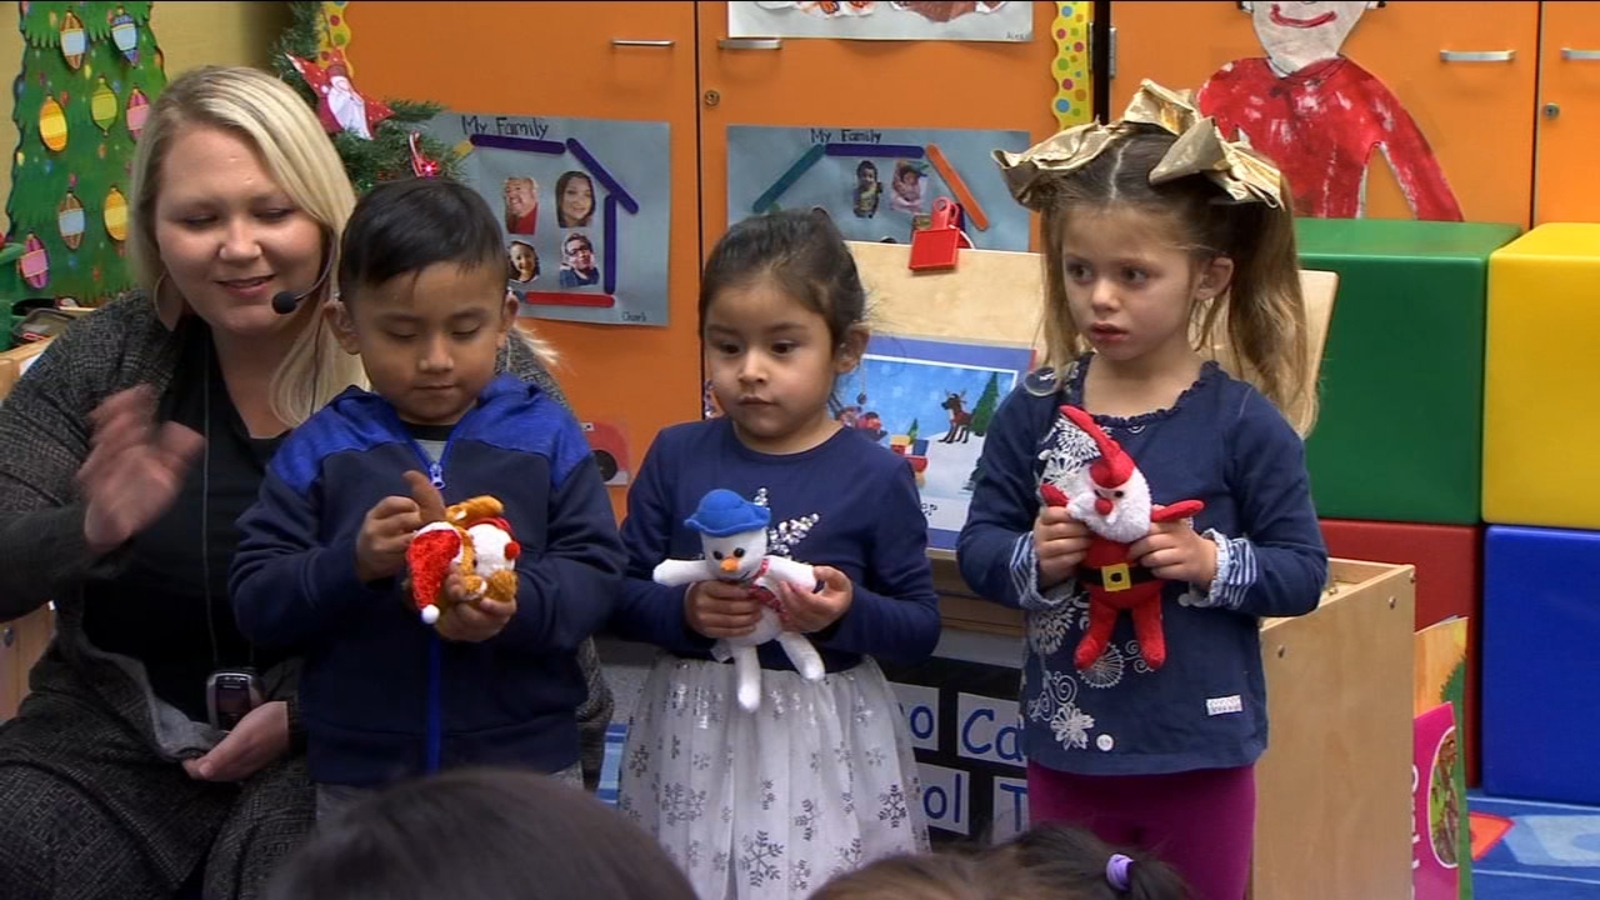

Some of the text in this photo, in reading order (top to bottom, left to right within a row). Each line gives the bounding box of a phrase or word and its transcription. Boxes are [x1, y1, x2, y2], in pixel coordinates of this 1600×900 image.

[461, 115, 549, 141] My Family
[811, 127, 882, 144] My Family
